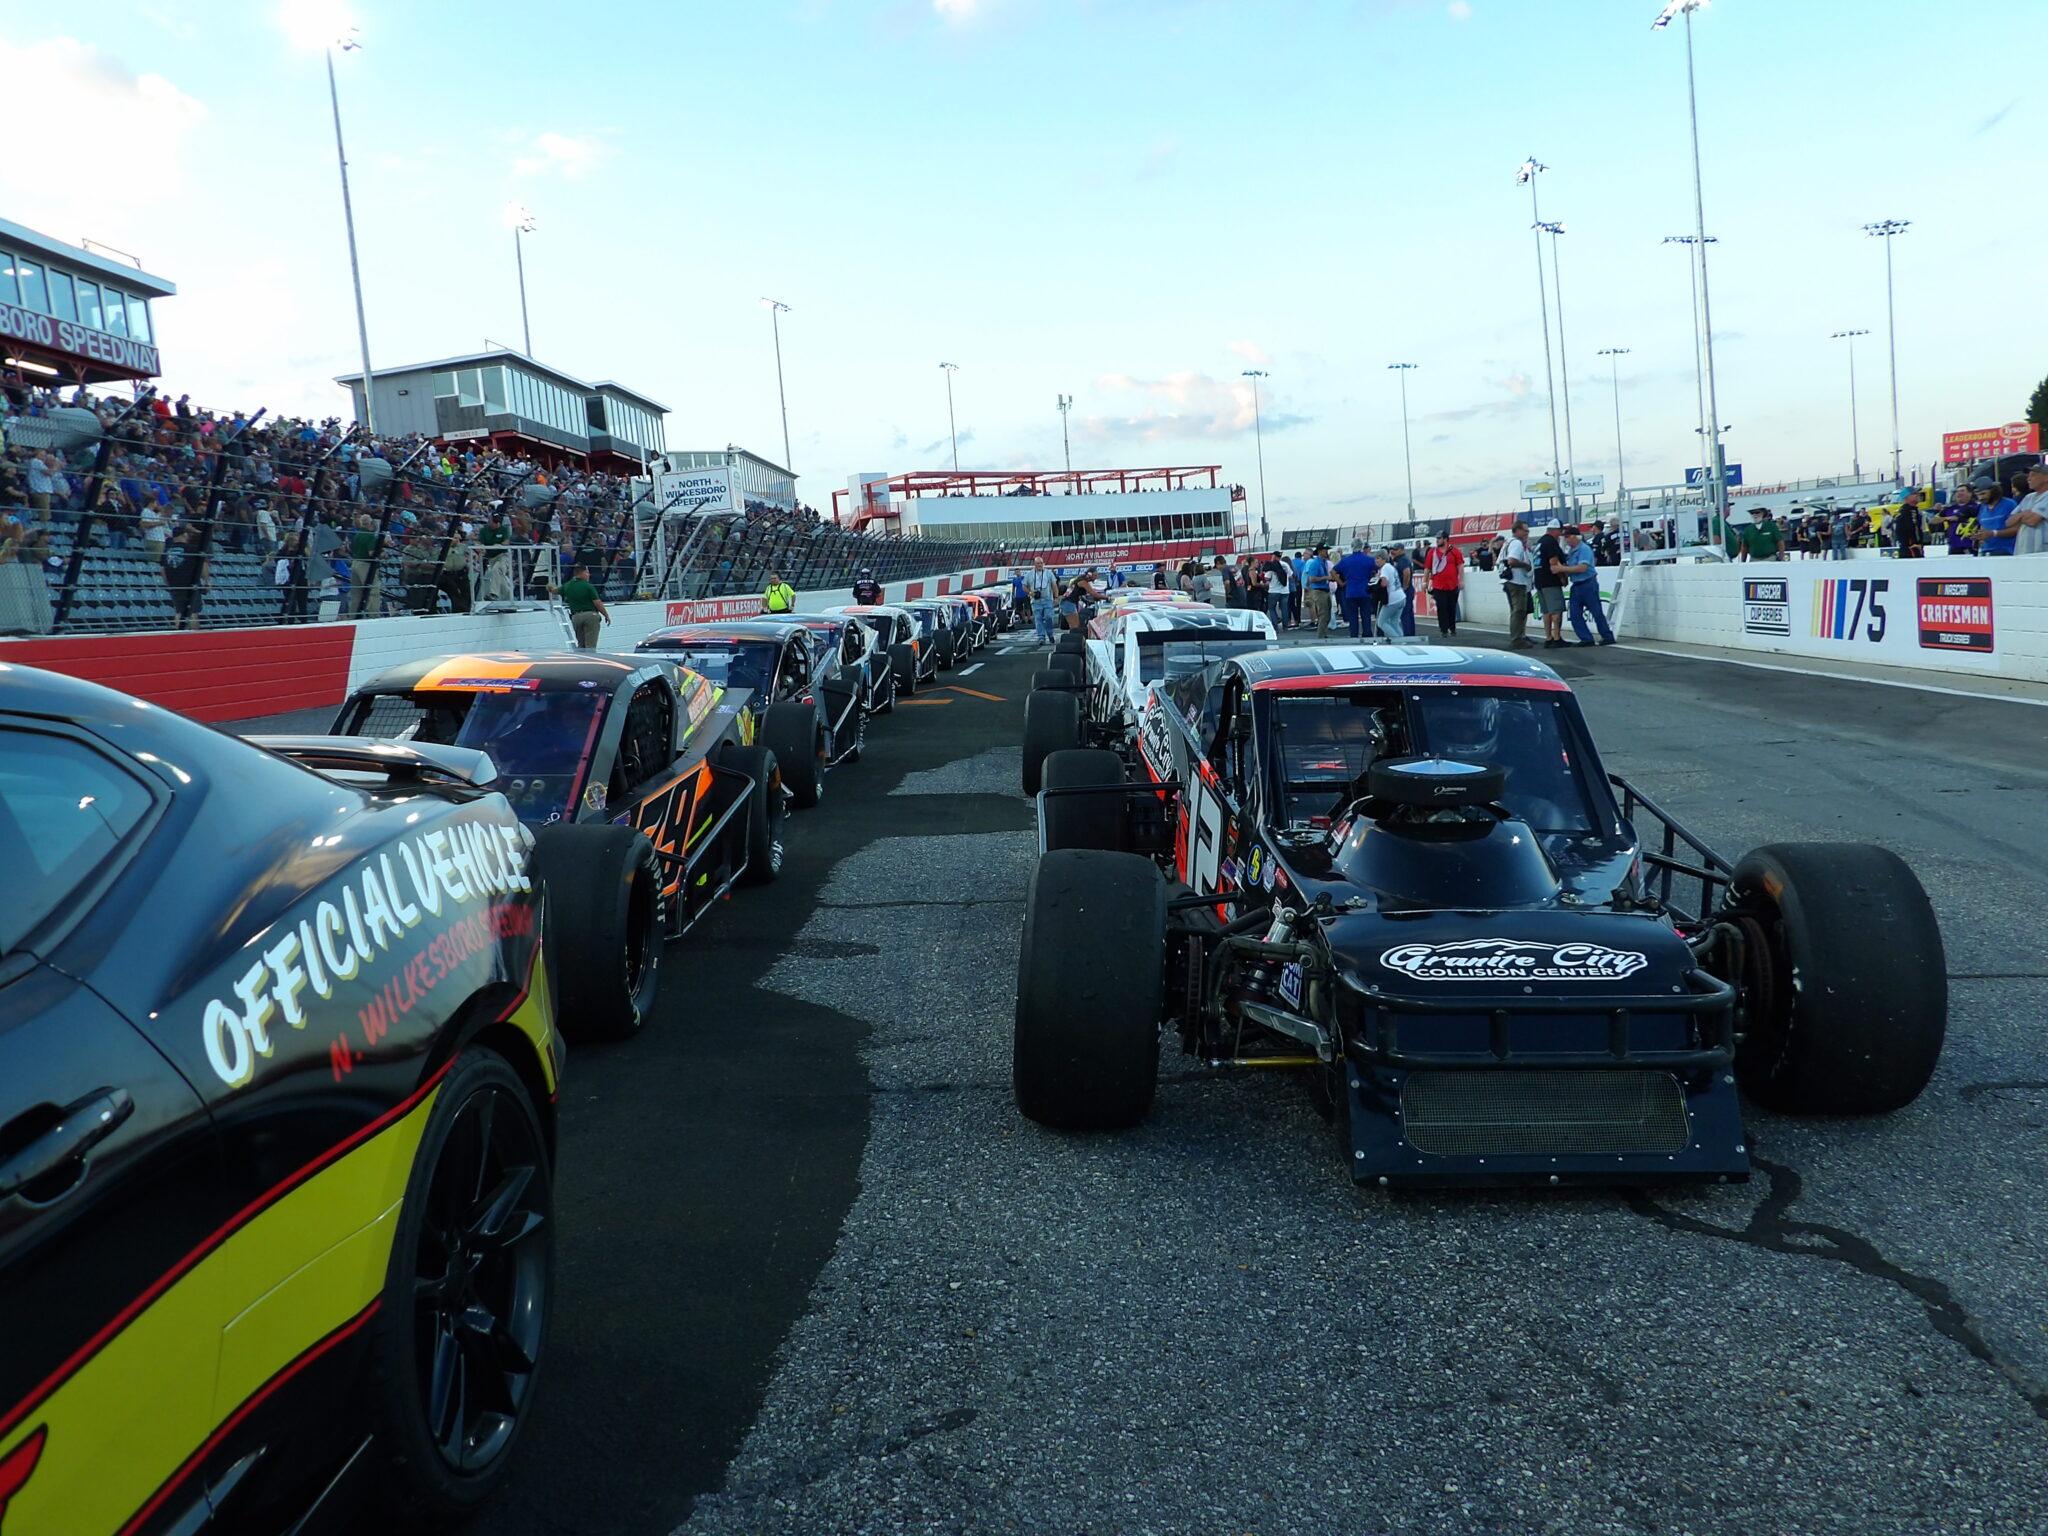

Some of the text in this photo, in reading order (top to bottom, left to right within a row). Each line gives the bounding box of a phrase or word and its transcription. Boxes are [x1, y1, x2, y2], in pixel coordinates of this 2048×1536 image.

[58, 321, 159, 374] SPEEDWAY
[1945, 431, 1998, 444] LEADERBOARD
[2004, 425, 2029, 435] Tyson
[679, 478, 712, 489] NORTH
[665, 485, 727, 499] WILKESBORO
[1065, 552, 1089, 561] NORTH
[1136, 563, 1154, 571] GEICO
[1757, 584, 1781, 600] NASCAR
[1944, 584, 1969, 596] NASCAR
[696, 599, 761, 618] NORTH WILKESBORO
[1751, 607, 1783, 622] CUP SERIES
[1848, 579, 1889, 643] 75
[1921, 604, 1989, 625] CRAFTSMAN
[203, 821, 533, 1088] OFFICIAL VEHICLE
[1388, 945, 1640, 973] Granite City
[1416, 966, 1615, 977] COLLISION CENTER
[330, 1032, 363, 1083] N.
[358, 917, 485, 1046] WILKESBORO
